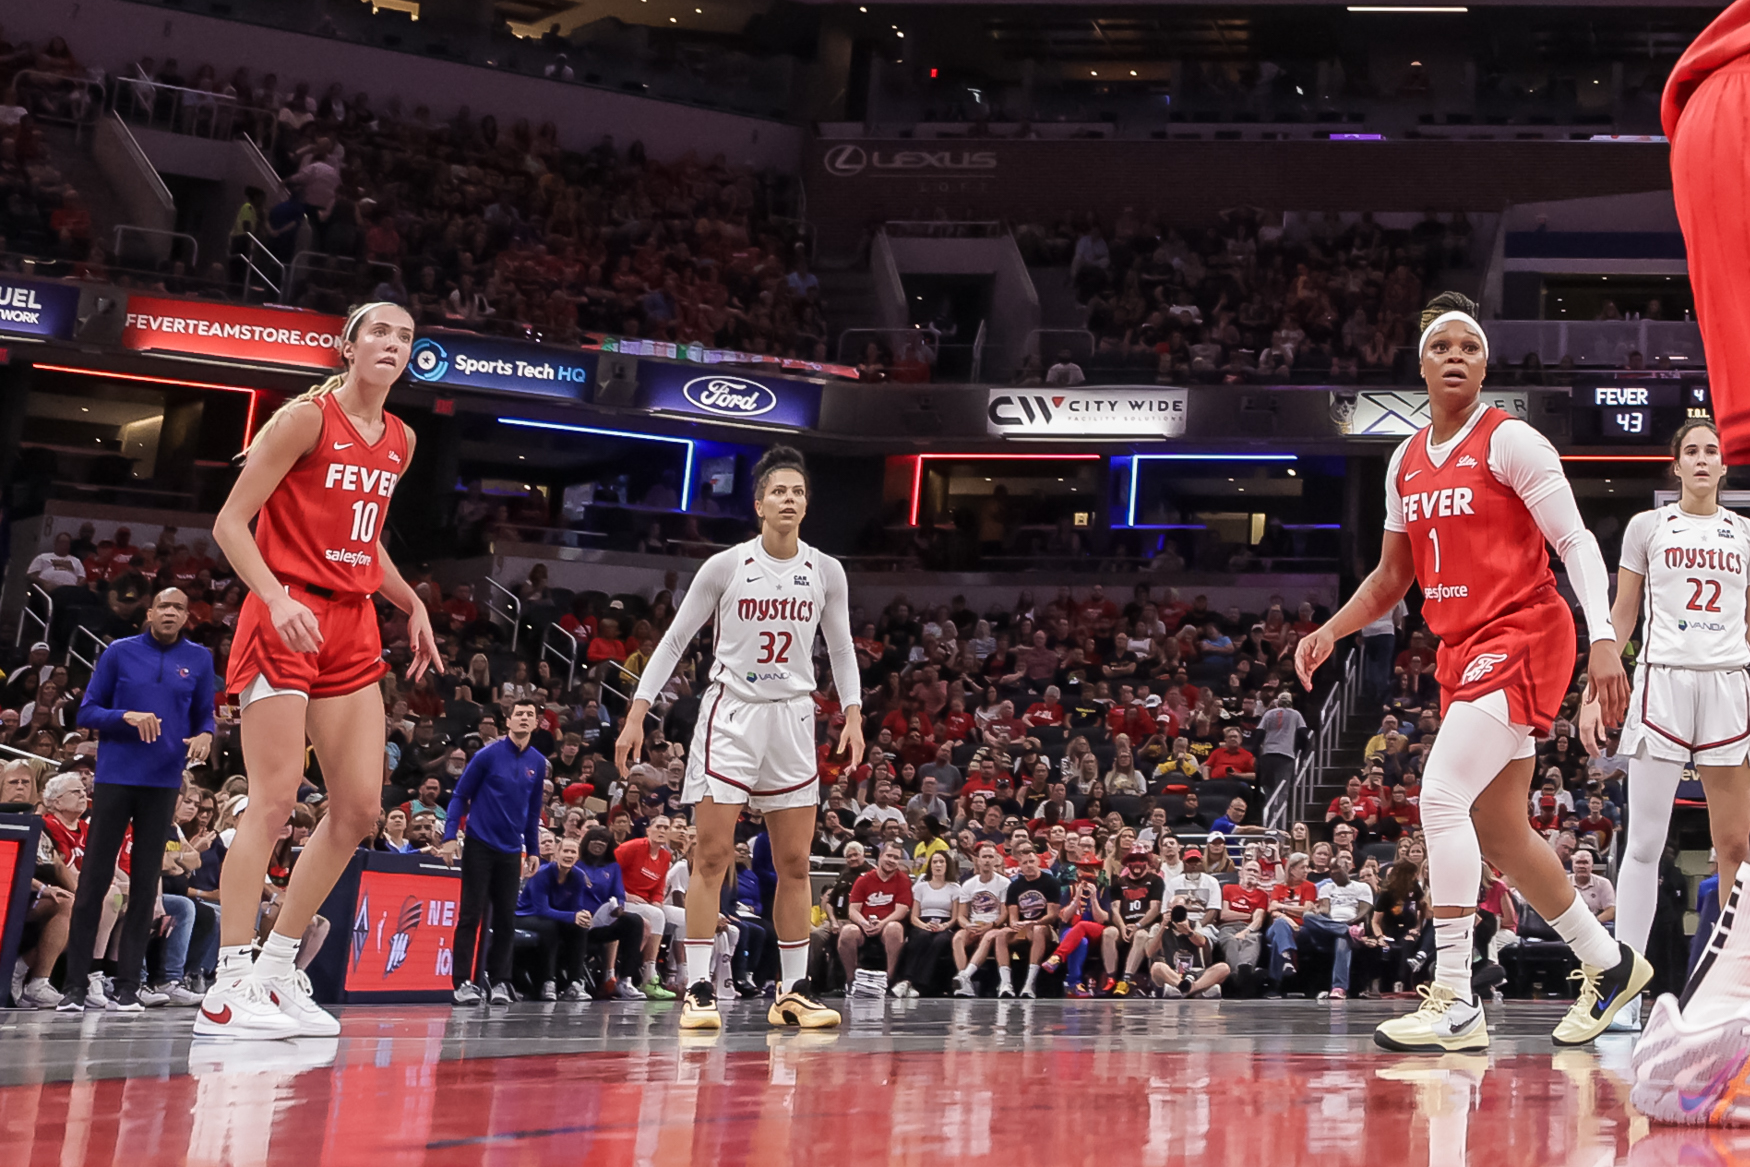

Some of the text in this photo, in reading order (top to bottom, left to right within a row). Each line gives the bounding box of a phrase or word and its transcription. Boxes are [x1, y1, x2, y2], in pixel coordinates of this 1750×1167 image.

[872, 150, 998, 169] LEXUS
[454, 353, 587, 384] Sports Tech HQ
[700, 379, 759, 411] Ford
[1069, 400, 1118, 412] CITY
[1128, 400, 1183, 412] WIDE
[1595, 387, 1648, 405] FEVER
[1693, 389, 1704, 402] 4
[1616, 412, 1643, 433] 43
[1402, 487, 1475, 524] FEVER
[350, 500, 379, 543] 10
[1428, 527, 1440, 573] 1
[1664, 546, 1742, 575] mystics
[738, 597, 813, 622] mystics
[1686, 577, 1722, 613] 22
[1689, 620, 1727, 632] VANDA
[757, 631, 793, 664] 32
